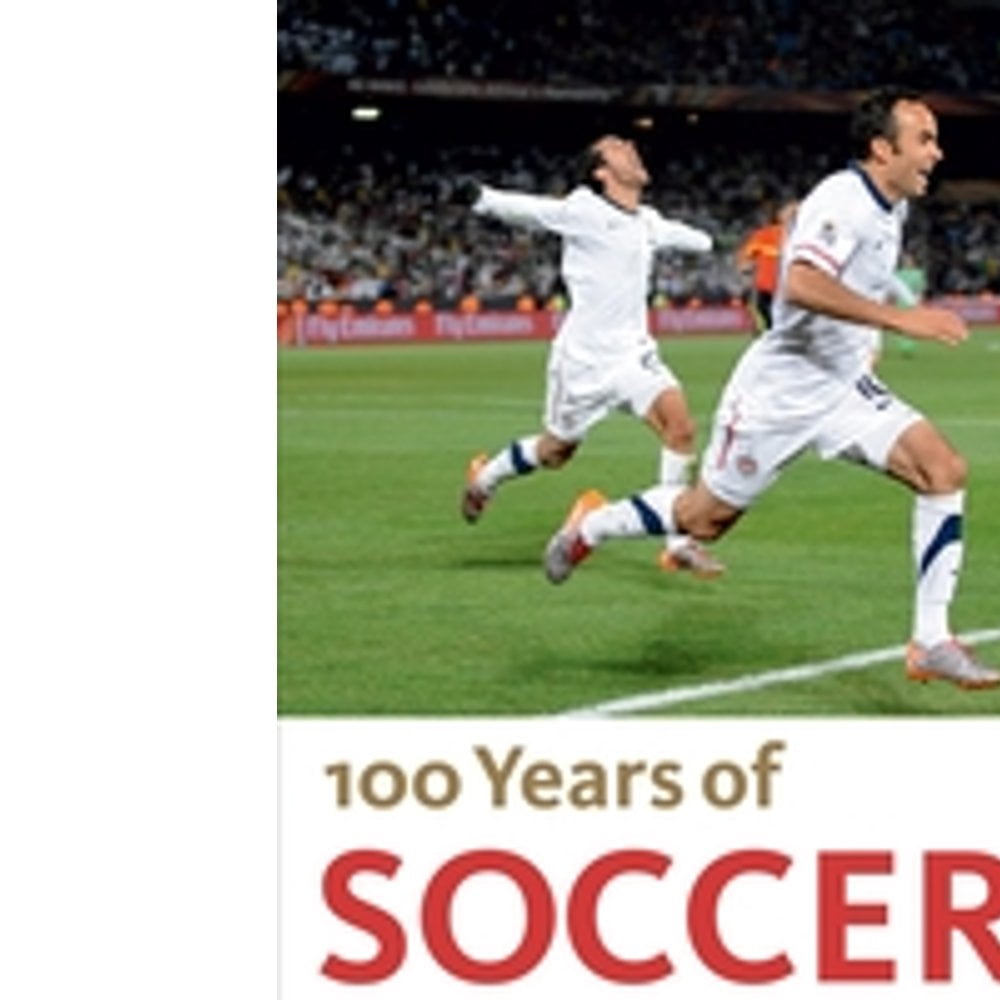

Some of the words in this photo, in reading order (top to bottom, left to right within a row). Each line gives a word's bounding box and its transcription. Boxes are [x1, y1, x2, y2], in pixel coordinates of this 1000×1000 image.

[324, 759, 463, 811] 100
[472, 744, 685, 811] Years
[701, 739, 788, 811] of
